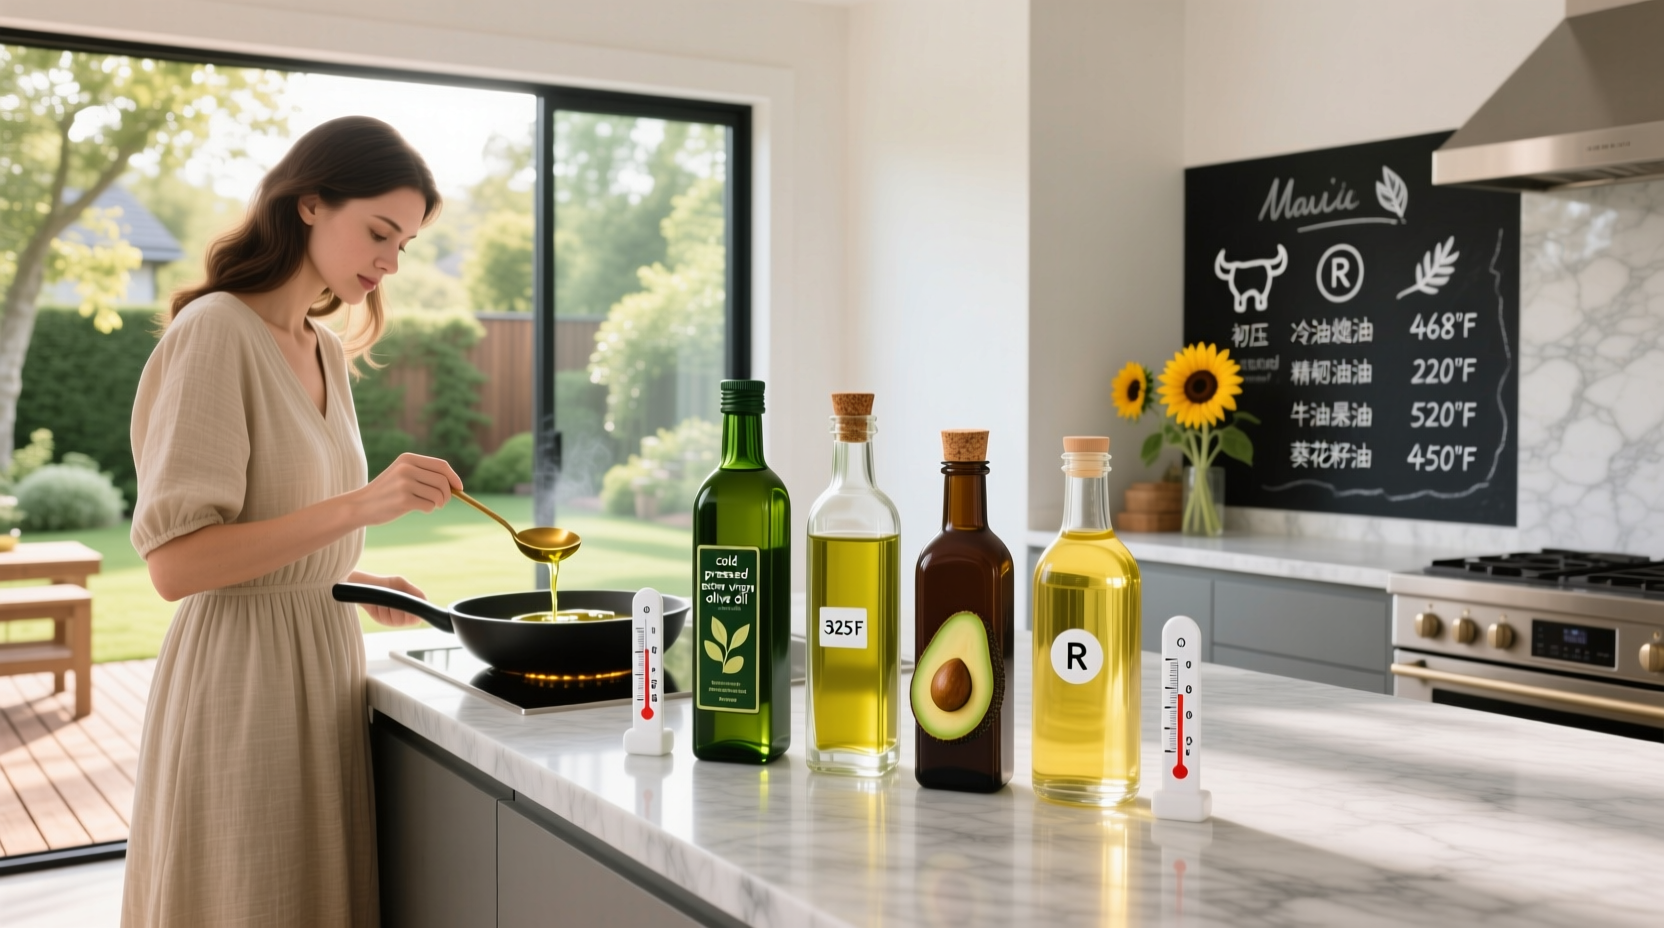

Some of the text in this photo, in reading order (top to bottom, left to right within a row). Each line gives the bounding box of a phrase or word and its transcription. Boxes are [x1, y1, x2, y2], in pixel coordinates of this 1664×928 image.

[1231, 322, 1269, 348] 初压
[1290, 400, 1373, 428] 牛油果油
[1290, 440, 1373, 469] 葵花籽油
[715, 554, 738, 567] cold
[824, 619, 864, 636] 325F
[1067, 641, 1088, 671] R
